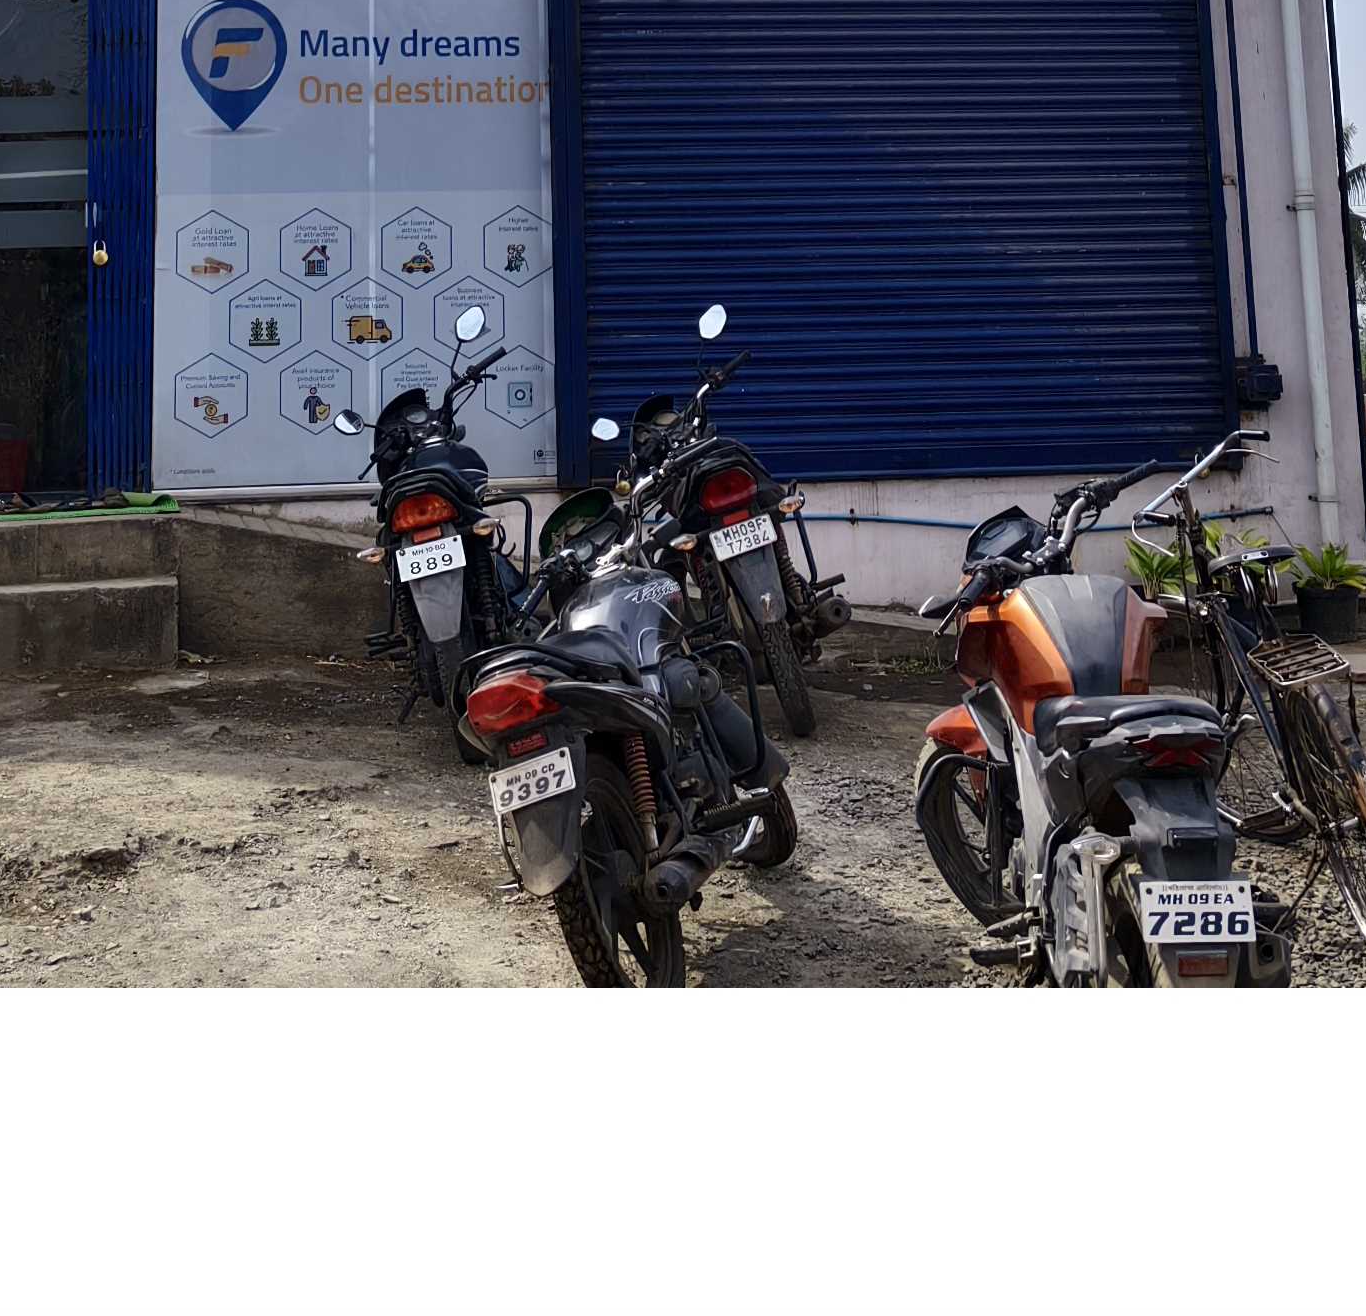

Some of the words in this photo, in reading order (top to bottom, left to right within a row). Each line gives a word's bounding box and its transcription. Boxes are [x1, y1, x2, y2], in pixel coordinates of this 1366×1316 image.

[300, 29, 390, 65] Many
[400, 29, 520, 57] dreams
[299, 77, 363, 104] One
[195, 227, 213, 235] Gold
[214, 227, 232, 235] Loan
[410, 553, 453, 574] 889
[500, 769, 566, 807] 9397
[1158, 894, 1183, 905] MH
[1188, 893, 1209, 904] 09
[1214, 893, 1234, 904] EA
[1148, 911, 1250, 936] 7286
